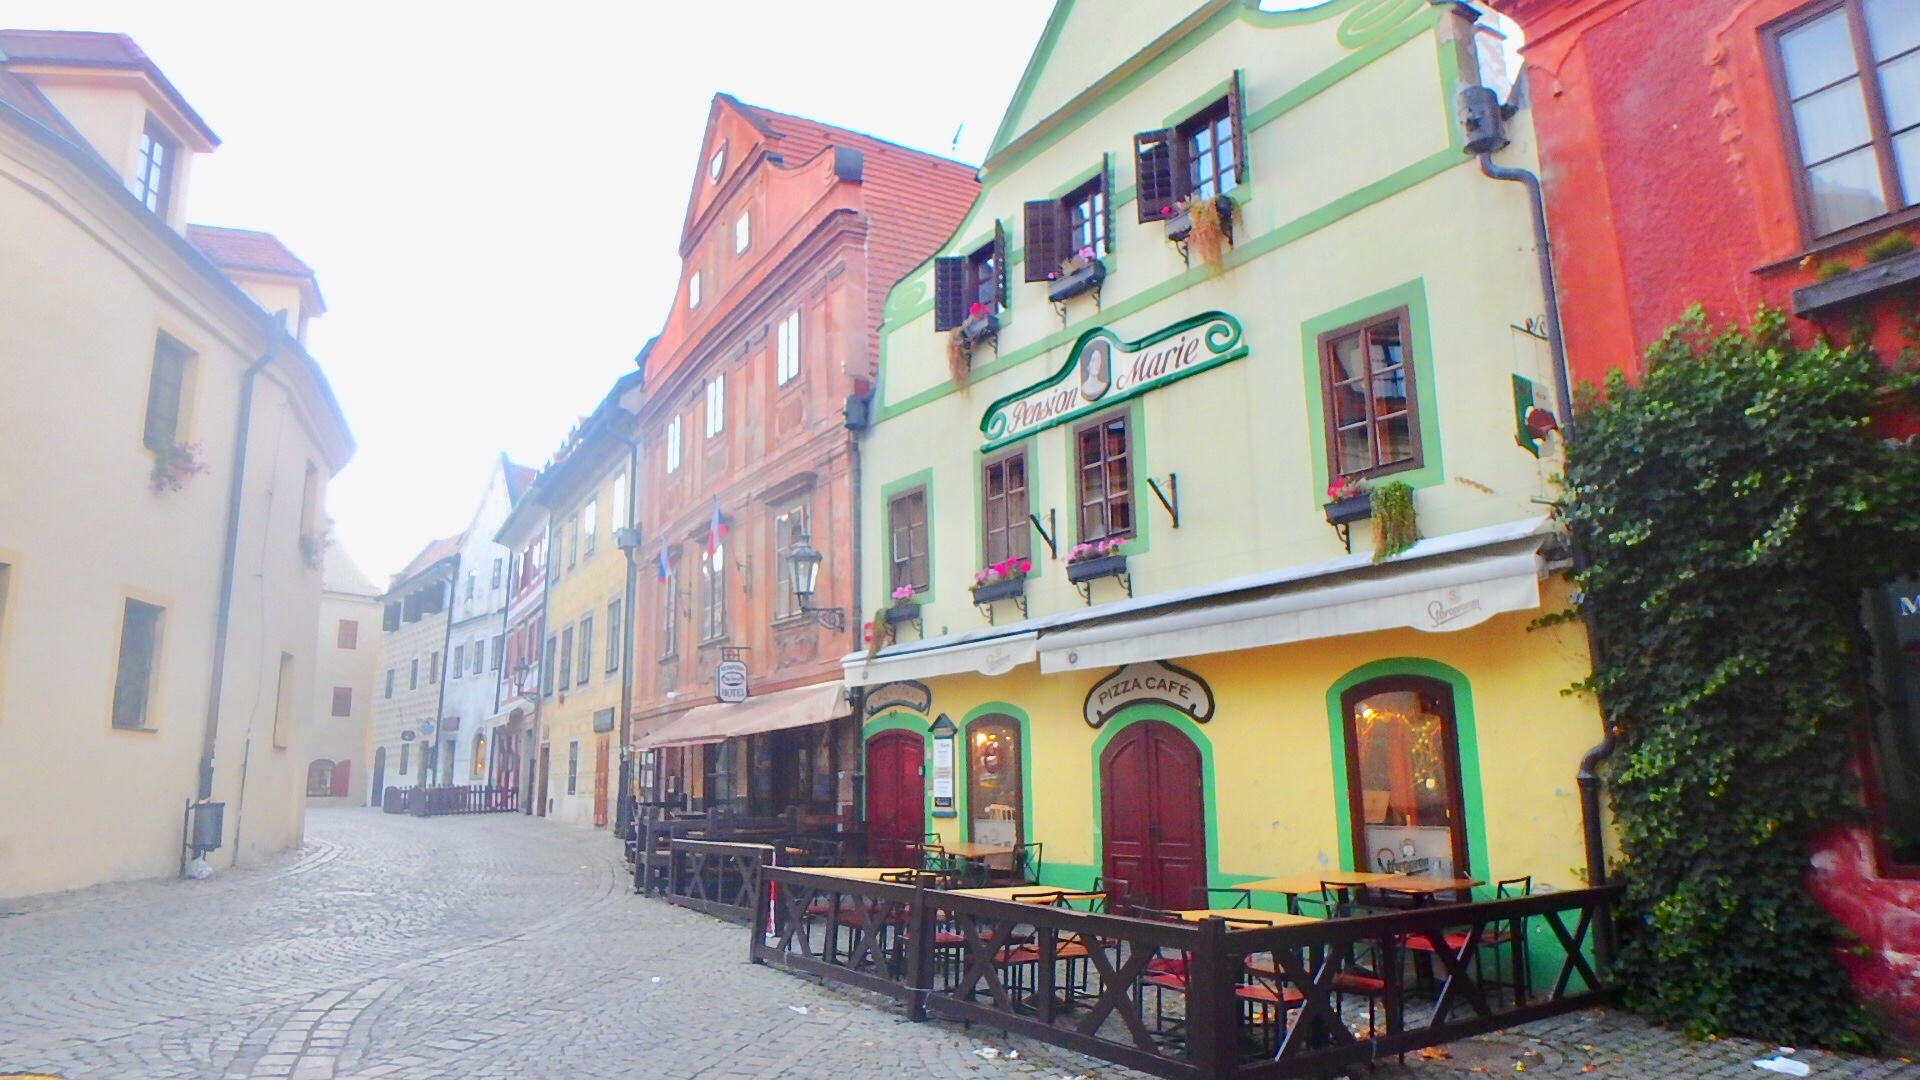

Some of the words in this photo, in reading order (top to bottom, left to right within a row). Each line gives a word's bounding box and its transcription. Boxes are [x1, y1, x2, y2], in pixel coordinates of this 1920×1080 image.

[1007, 386, 1079, 434] Pension
[1116, 336, 1199, 390] Marie
[721, 688, 745, 697] HOTEL
[1098, 678, 1142, 706] PIZZA
[1145, 677, 1191, 700] CAFÉ
